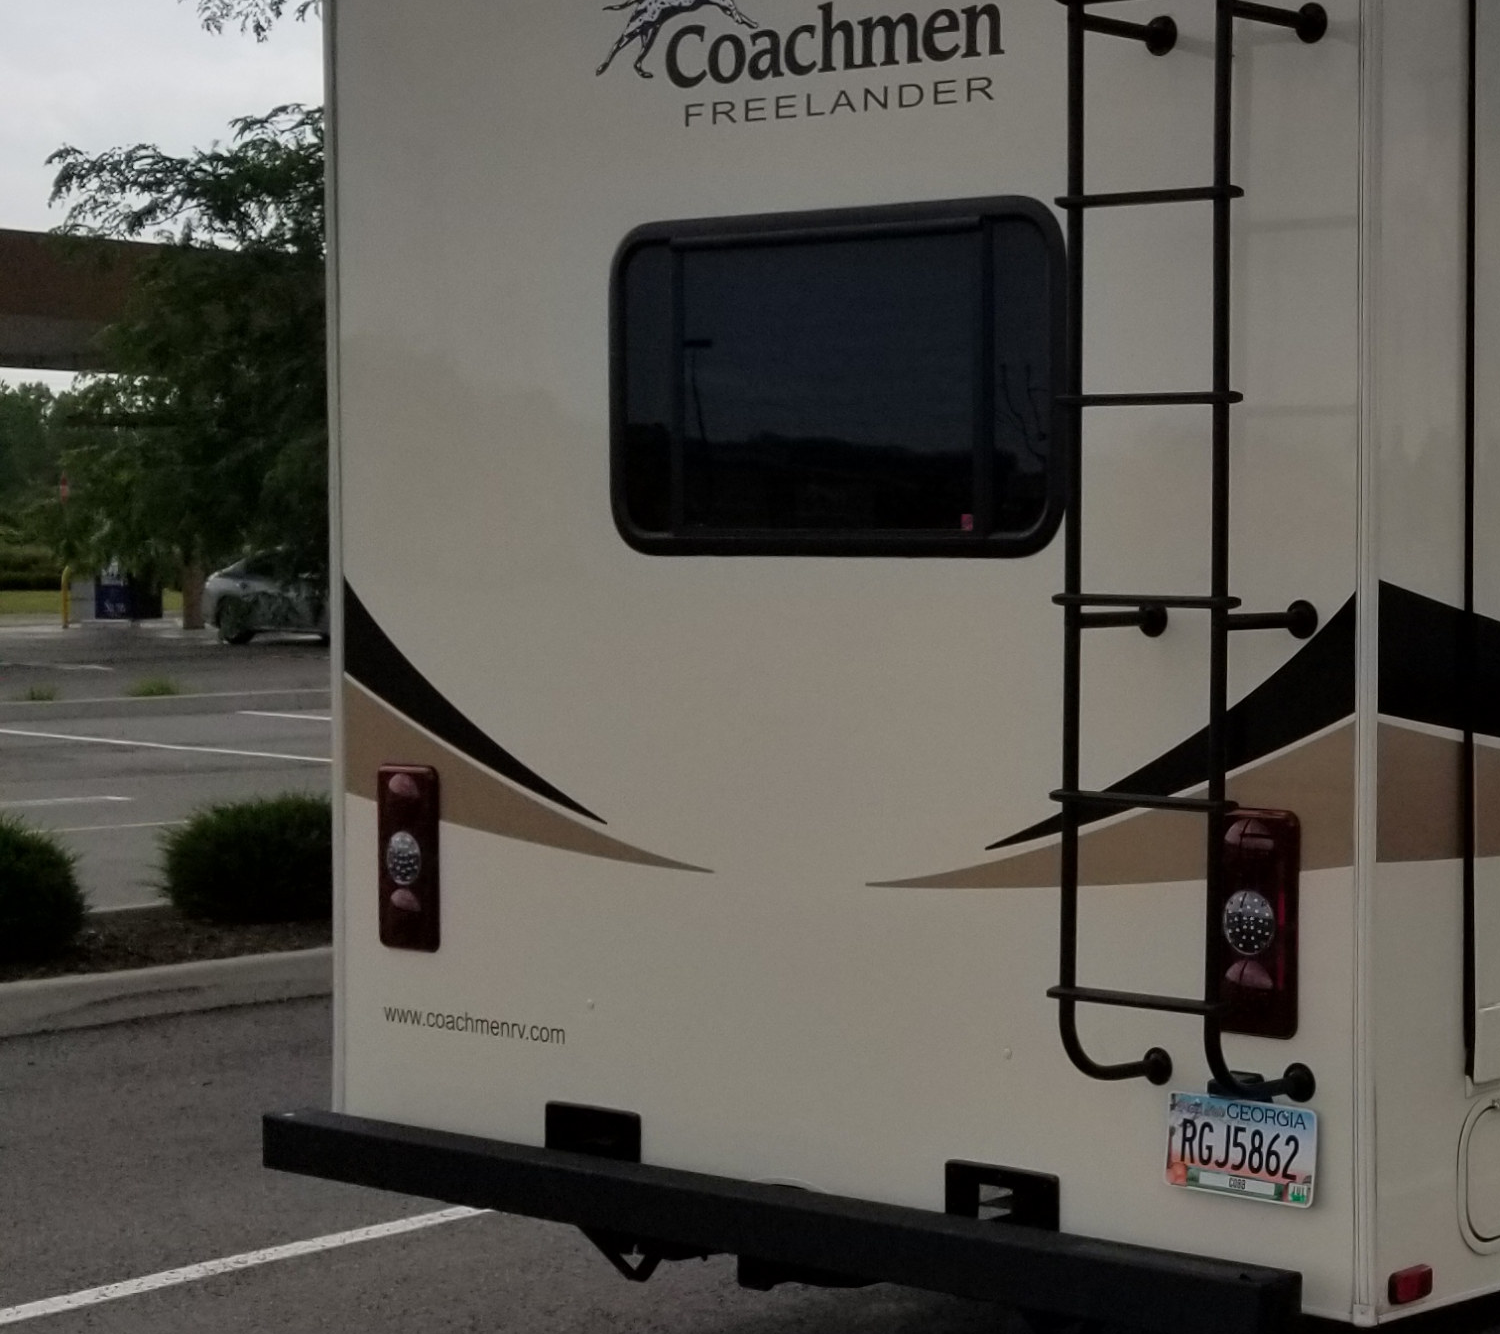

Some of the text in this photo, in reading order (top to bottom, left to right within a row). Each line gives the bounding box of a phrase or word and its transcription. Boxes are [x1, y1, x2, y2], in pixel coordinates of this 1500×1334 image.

[666, 1, 1005, 88] Coachmen
[684, 76, 995, 127] FREELANDER
[384, 1005, 566, 1045] www.coachmenrv.com
[1226, 1103, 1307, 1130] GEORGIA
[1180, 1118, 1300, 1181] RGJ5862
